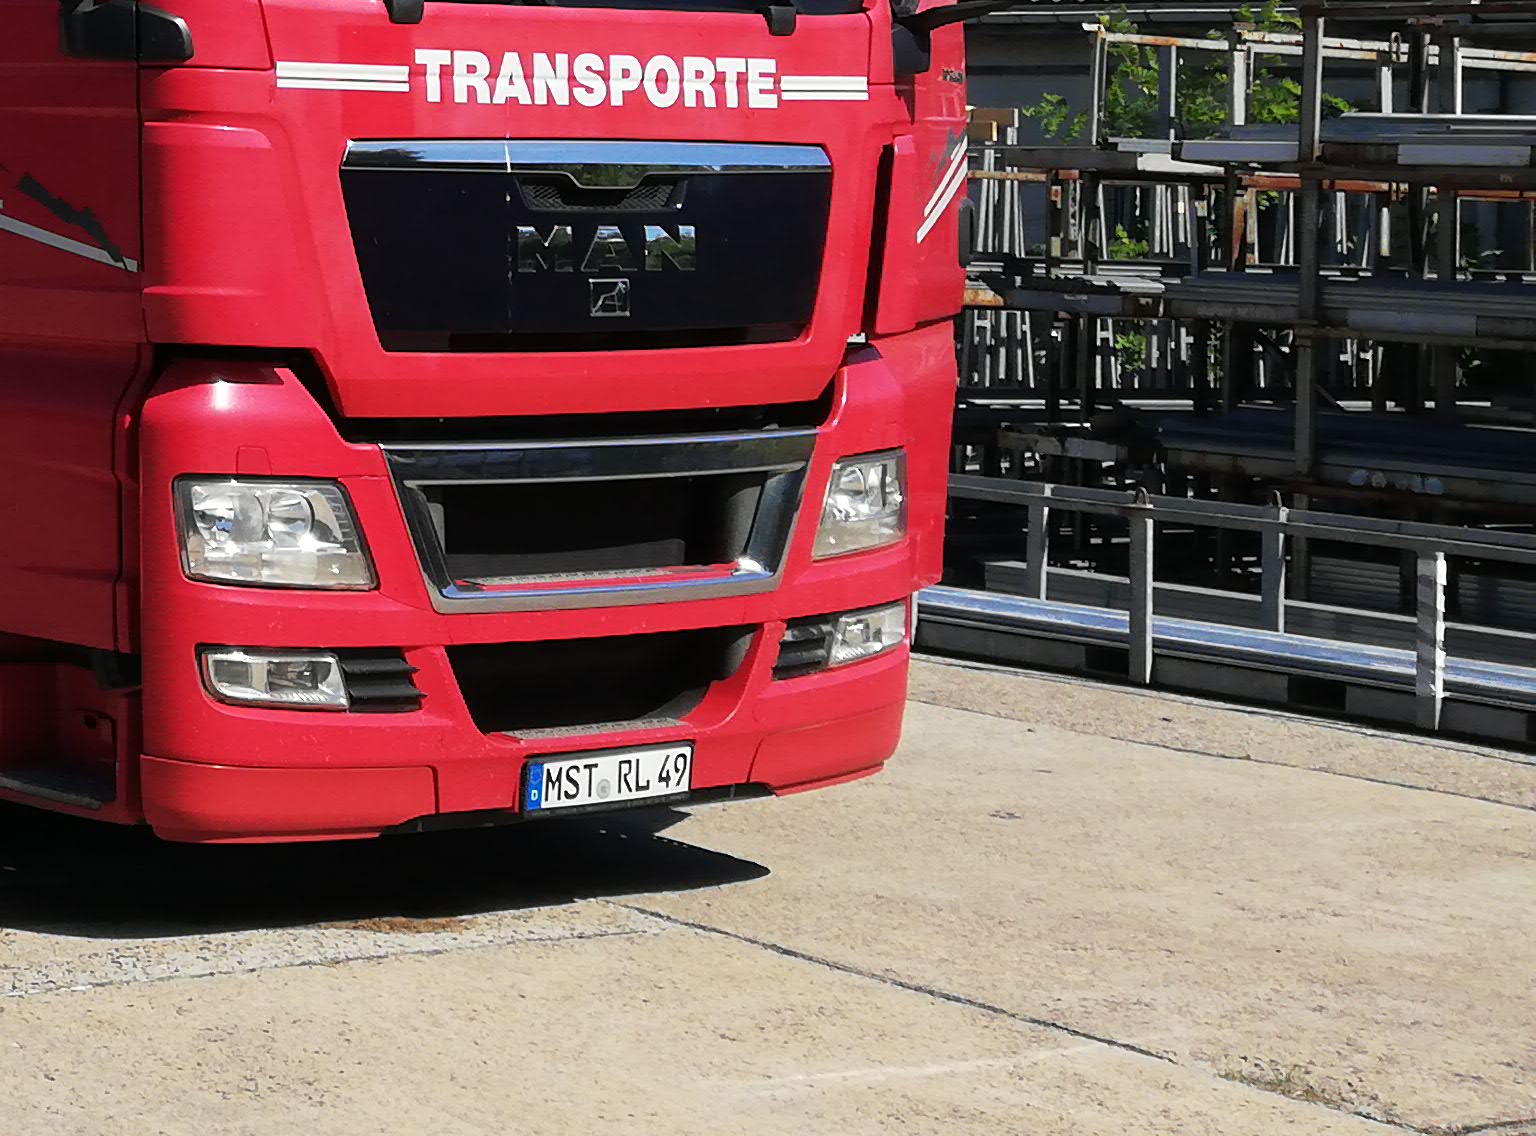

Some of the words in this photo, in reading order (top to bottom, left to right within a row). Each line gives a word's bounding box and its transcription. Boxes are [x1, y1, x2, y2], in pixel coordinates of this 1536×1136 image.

[414, 48, 779, 110] TRANSPORTE
[516, 225, 696, 273] MAN
[530, 789, 539, 801] D
[544, 763, 599, 802] MST
[617, 758, 650, 795] RL
[657, 753, 688, 789] 49
